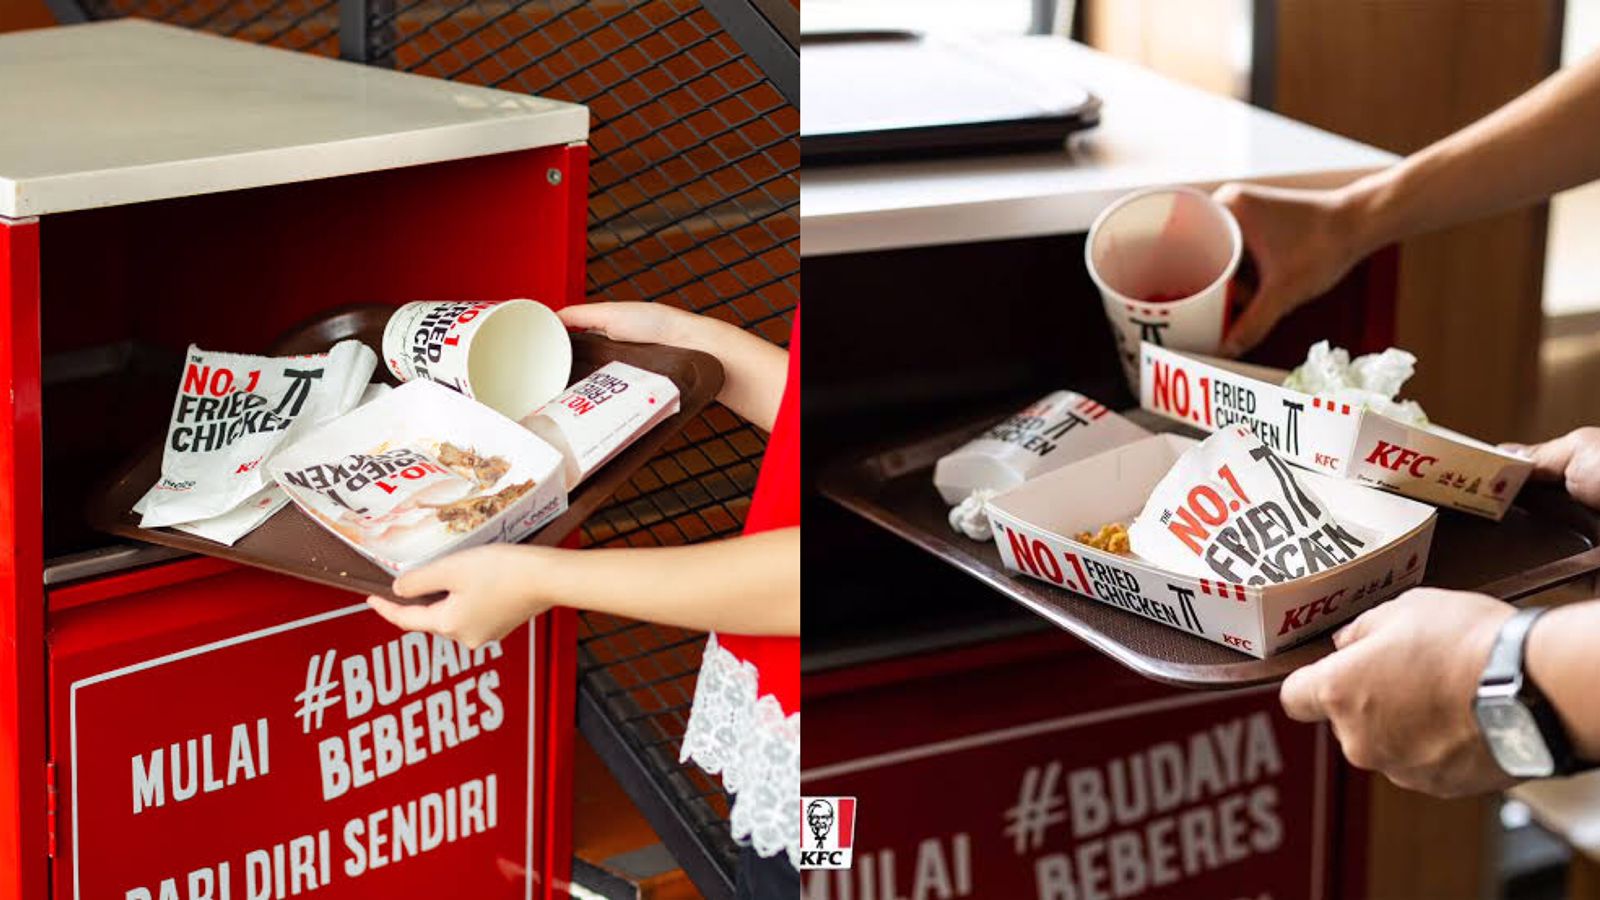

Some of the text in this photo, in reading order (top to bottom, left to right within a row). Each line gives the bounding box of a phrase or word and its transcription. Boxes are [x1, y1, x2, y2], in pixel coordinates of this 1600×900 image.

[412, 303, 448, 381] HICKE
[428, 301, 481, 363] RIED
[177, 390, 268, 423] FRIED
[183, 363, 261, 398] NO.1
[1153, 361, 1213, 427] NO.1
[1213, 379, 1257, 414] FRIED
[1314, 452, 1341, 470] KFC
[1365, 440, 1439, 478] KFC
[1160, 508, 1173, 525] THE
[1168, 464, 1250, 557] NO.1
[1006, 527, 1094, 596] NO.1
[1083, 556, 1141, 593] FRIED
[1093, 580, 1181, 626] CHICKEN
[1278, 589, 1346, 636] KFC
[1222, 633, 1252, 651] KFC
[318, 670, 504, 801] BEBERES
[131, 718, 270, 814] MULAI
[1005, 711, 1283, 854] #BUDAYA
[125, 774, 498, 900] RI DIRI SENDIRI
[1036, 786, 1284, 900] BEBERES
